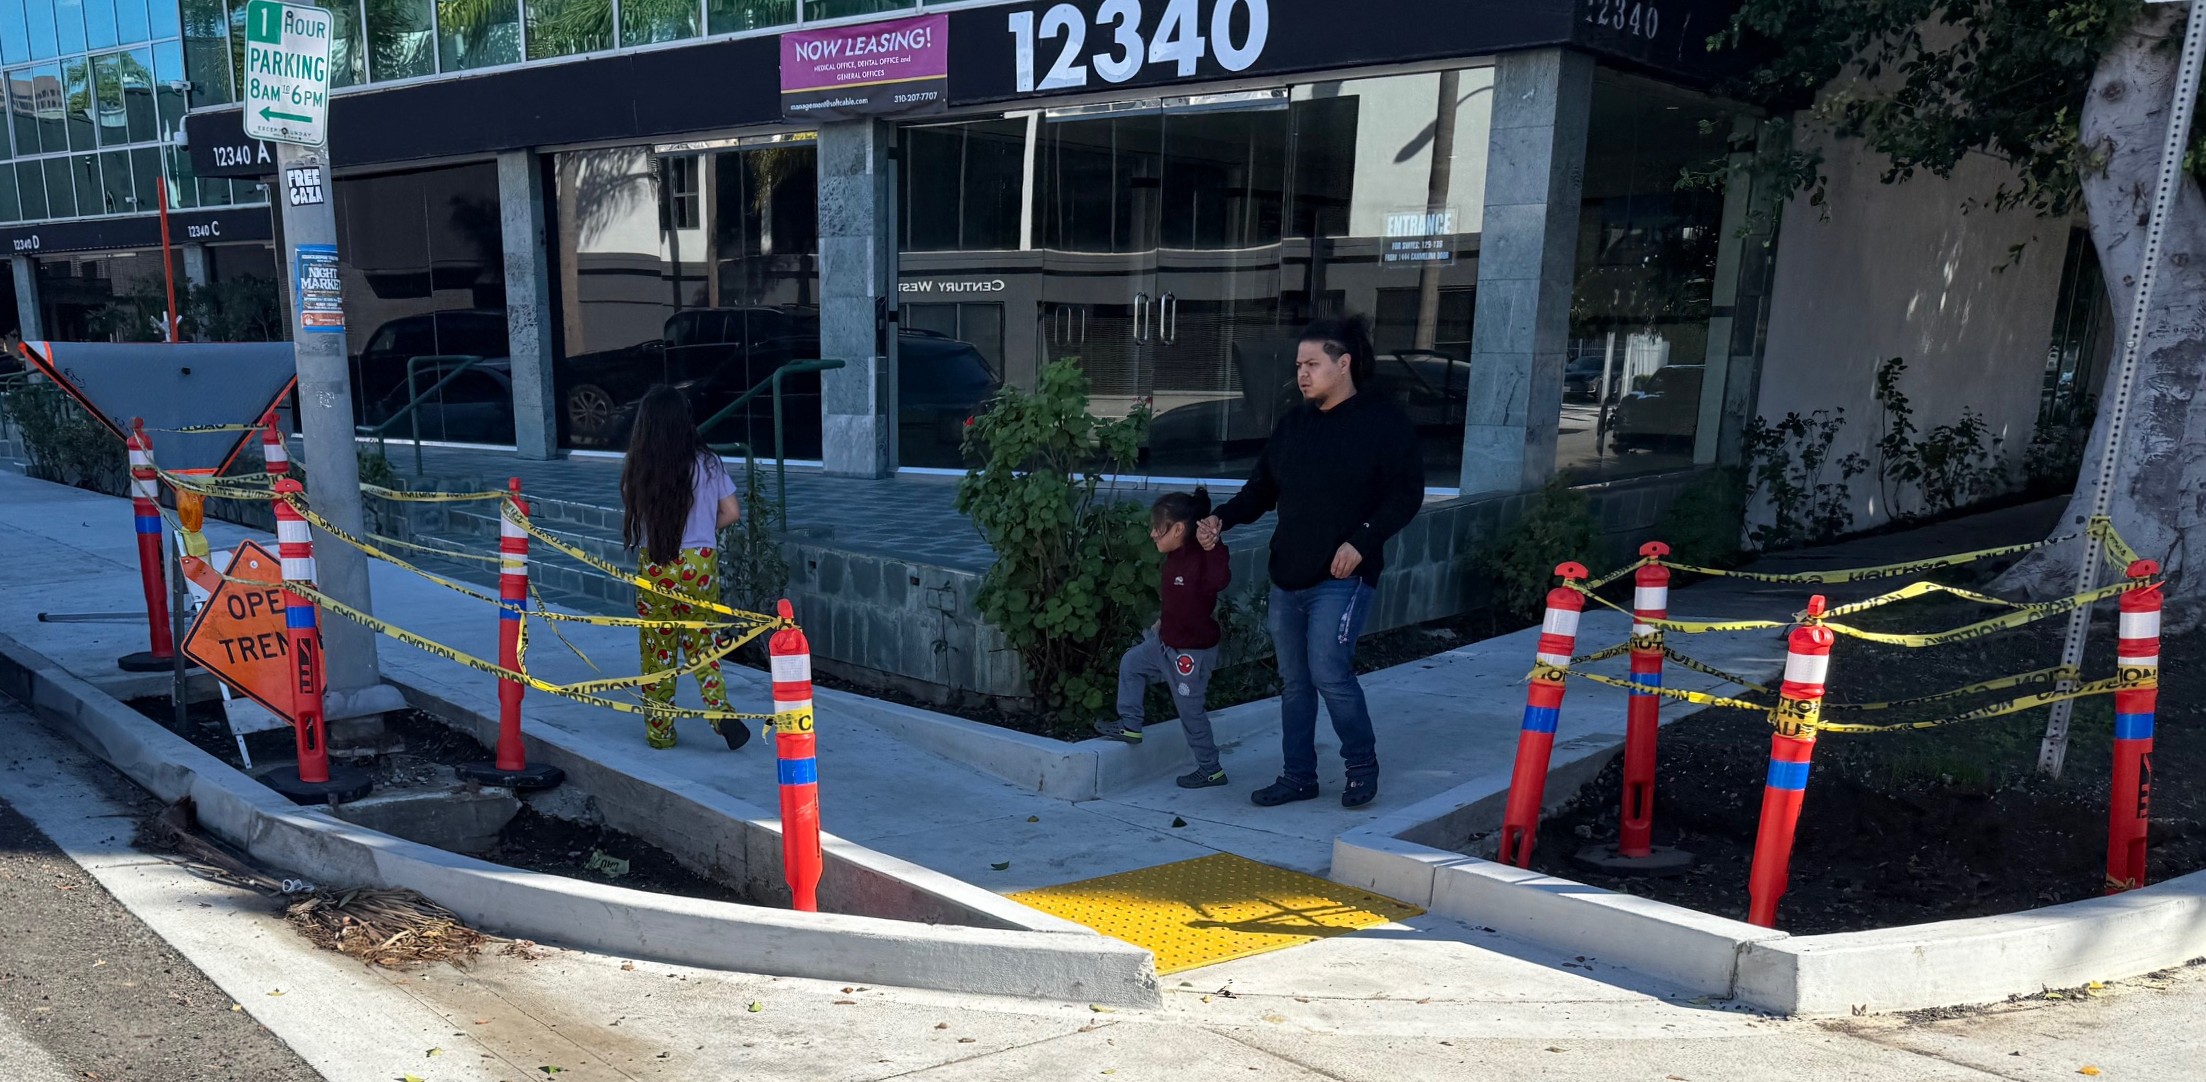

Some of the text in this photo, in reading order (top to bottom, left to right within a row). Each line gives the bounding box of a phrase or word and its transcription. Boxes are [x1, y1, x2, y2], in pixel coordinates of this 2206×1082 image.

[261, 8, 325, 39] 1 HOUR
[795, 27, 932, 62] NOW LEASING!
[1009, 0, 1269, 92] 12340
[250, 47, 325, 82] PARKING
[814, 64, 836, 72] MEDICAL
[857, 59, 879, 68] DENTAL
[880, 56, 899, 65] OFFICE
[837, 69, 885, 81] GENERAL OFFICES
[250, 78, 280, 102] 8AM
[291, 84, 323, 108] 6PM
[894, 91, 938, 103] 310-207-7707
[213, 139, 271, 167] 12340 A
[286, 168, 321, 188] FREE
[290, 186, 324, 205] GAZA
[188, 221, 220, 238] 12340 C
[1387, 213, 1452, 237] ENTRANCE
[13, 235, 40, 250] 12340 D
[308, 267, 337, 279] NIGHT
[227, 589, 286, 620] OPE
[219, 631, 289, 665] TREN
